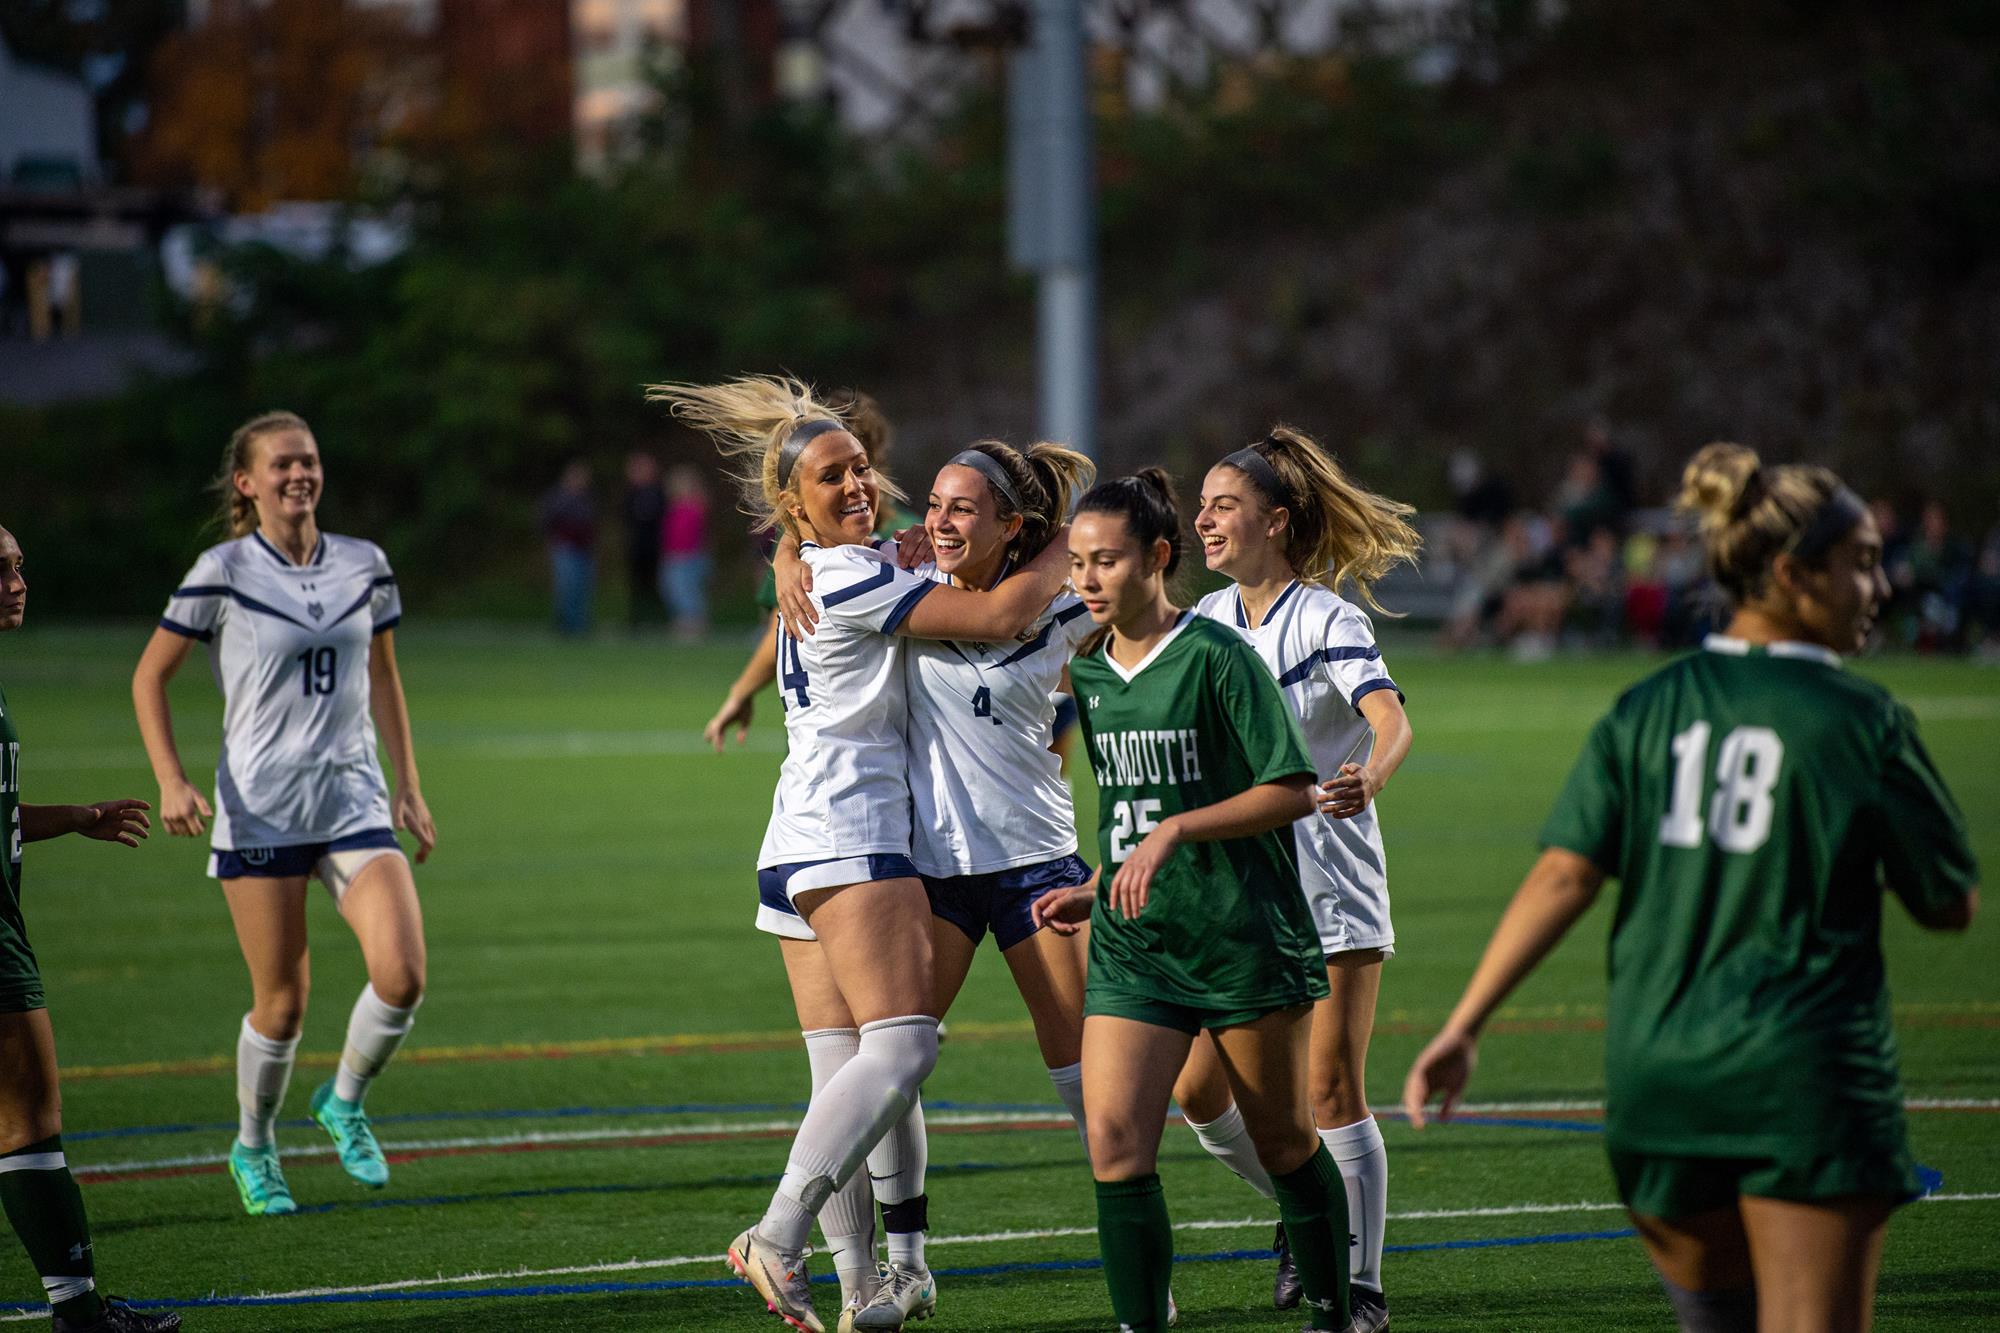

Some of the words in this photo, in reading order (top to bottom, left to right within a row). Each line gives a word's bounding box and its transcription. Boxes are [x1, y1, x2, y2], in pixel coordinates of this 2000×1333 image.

[298, 647, 337, 696] 19
[971, 685, 1003, 725] 4
[1095, 729, 1202, 786] YMOUTH
[1659, 720, 1784, 854] 18
